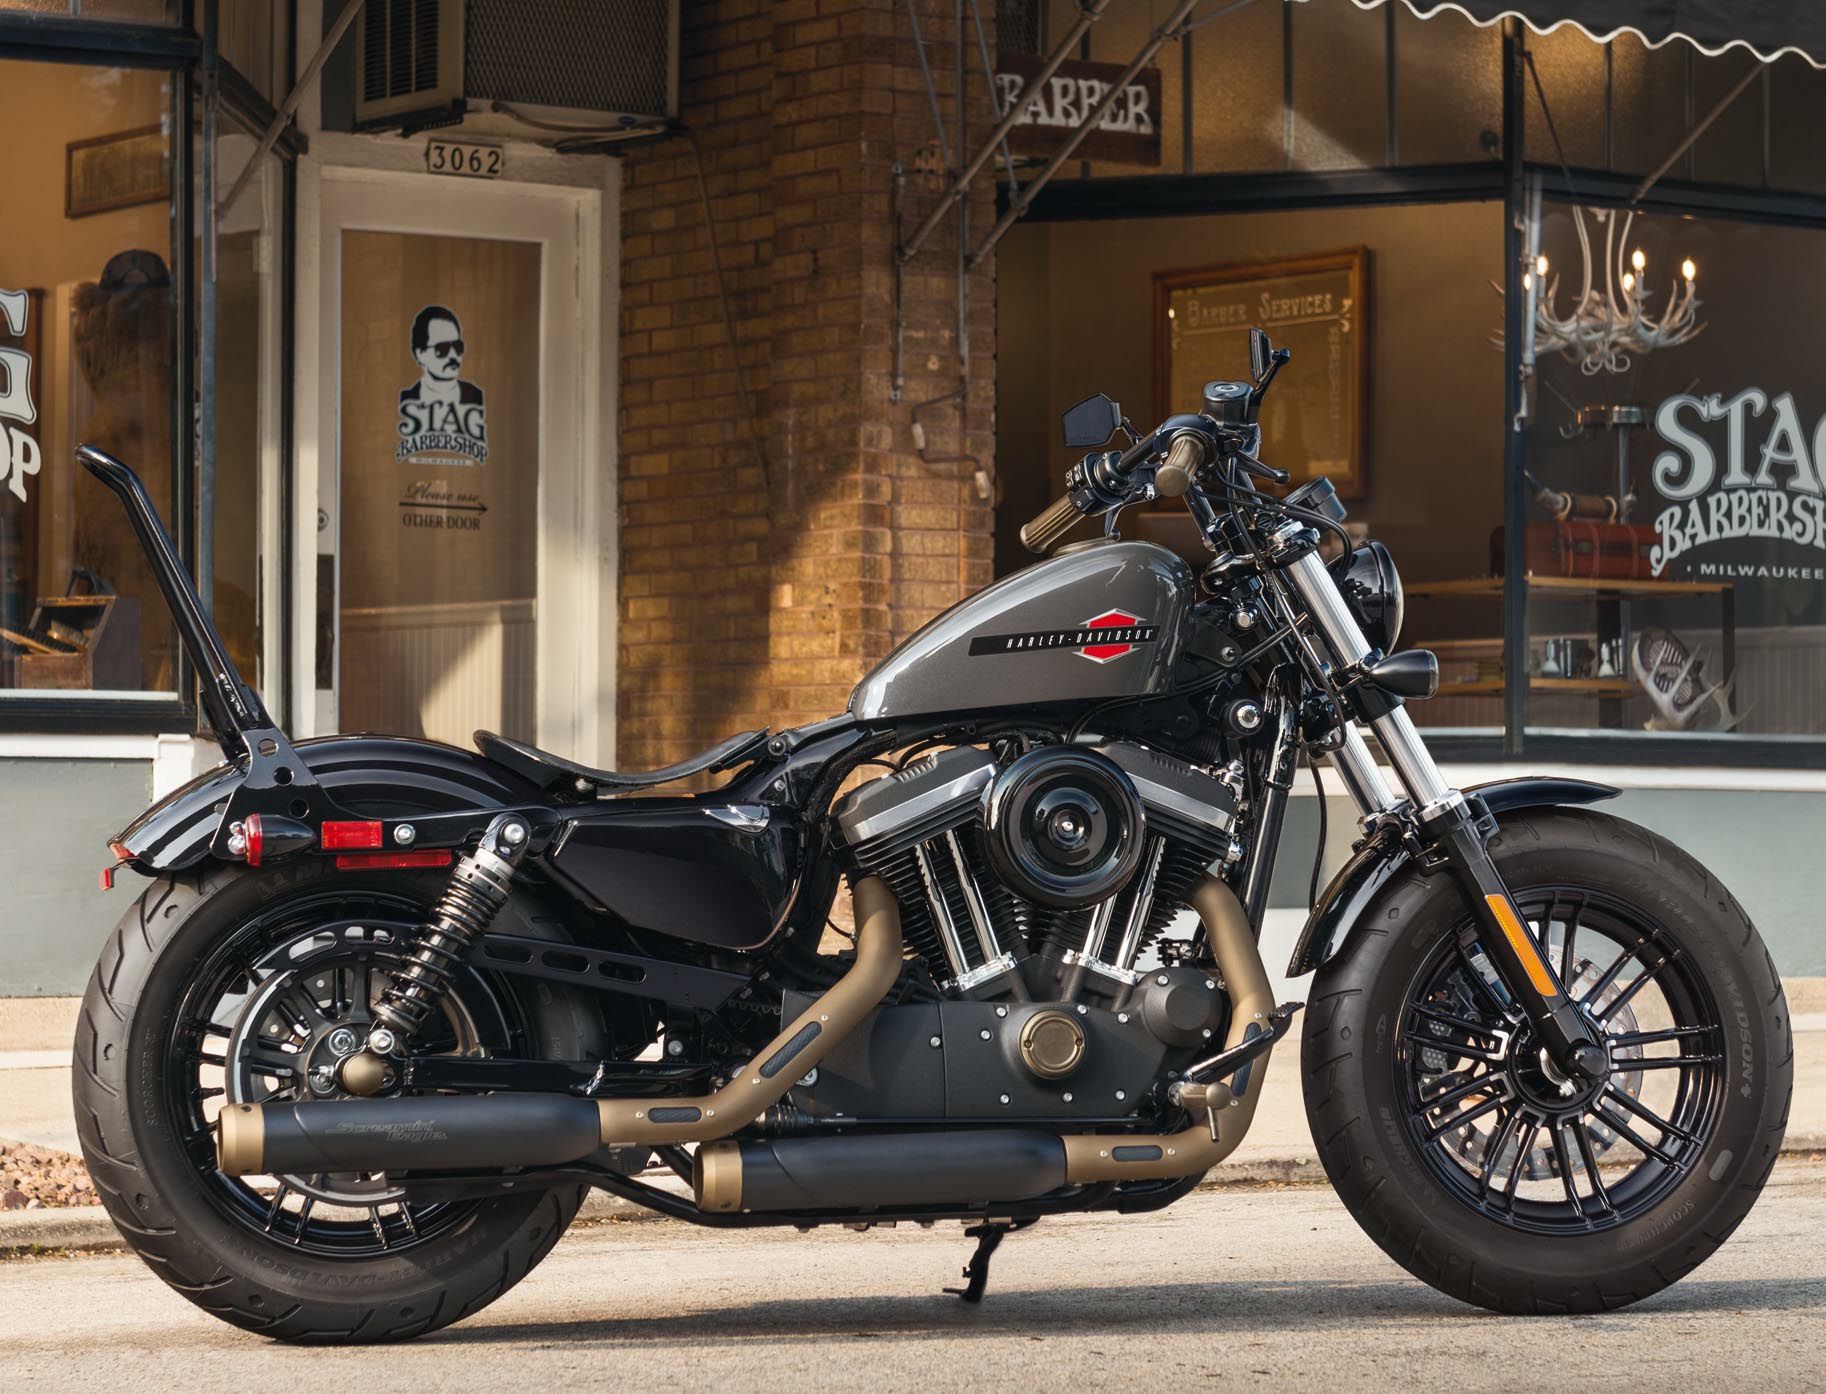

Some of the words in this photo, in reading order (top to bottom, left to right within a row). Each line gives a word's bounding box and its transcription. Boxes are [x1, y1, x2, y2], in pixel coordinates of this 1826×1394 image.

[432, 145, 500, 174] 3062
[1258, 291, 1332, 320] SERVICES
[398, 400, 485, 442] STAG
[397, 433, 488, 464] BARBERSHOP
[1653, 389, 1826, 500] STA
[405, 481, 453, 502] Please
[456, 493, 481, 503] use
[402, 513, 444, 529] OTHER
[446, 515, 481, 530] DOOR
[1700, 563, 1824, 580] MILWAUKEE
[1006, 629, 1153, 649] HARLEY-DAVIDSON
